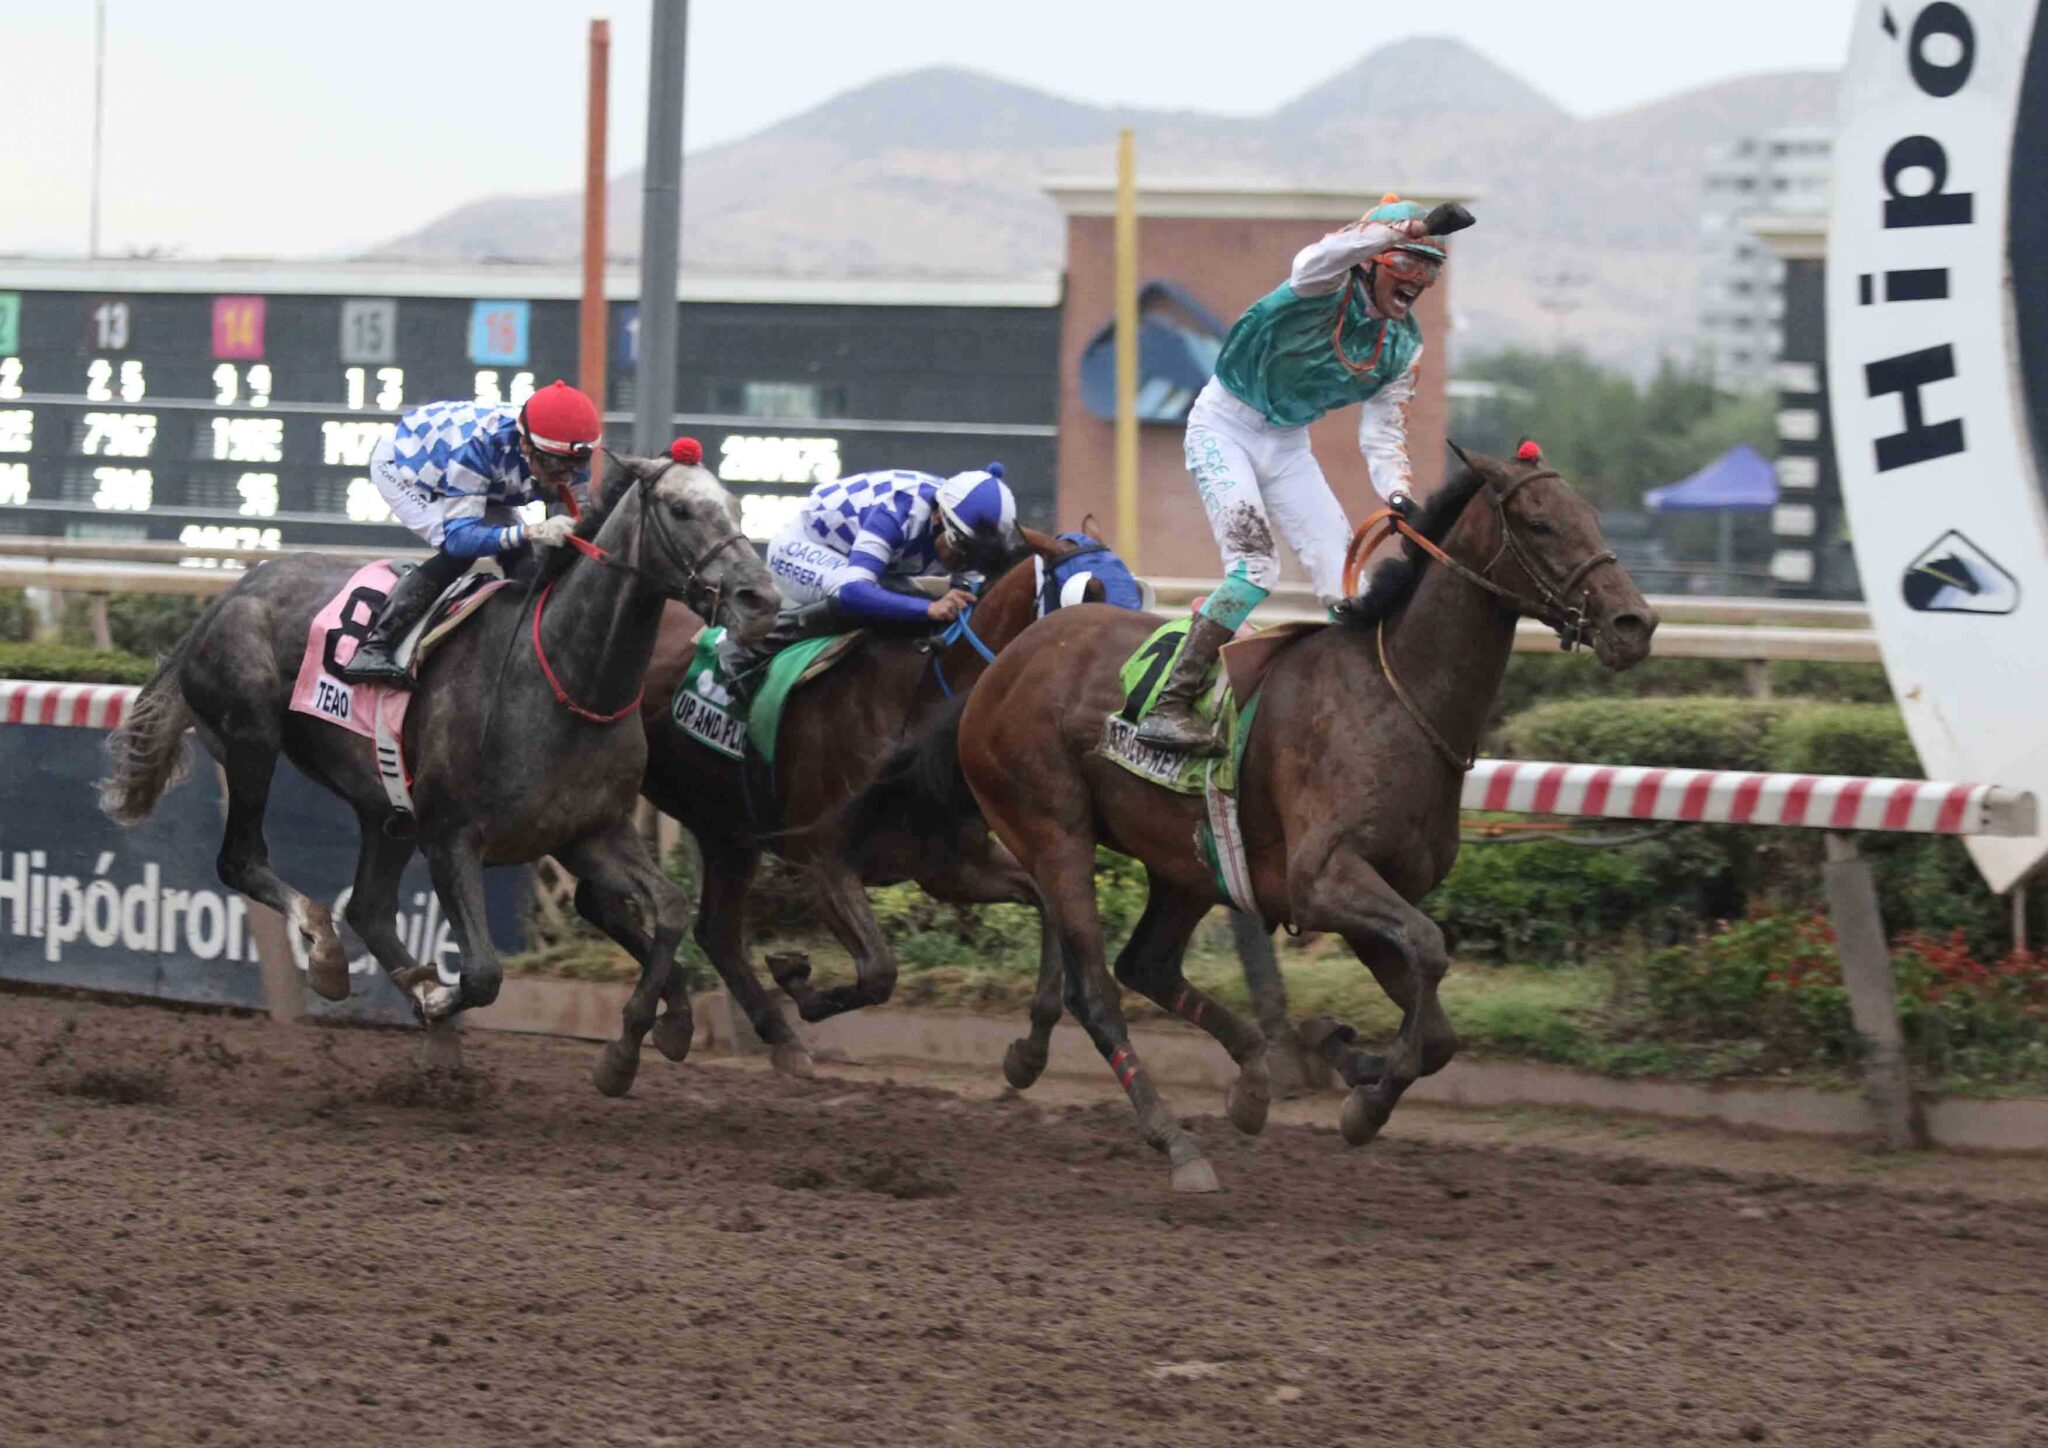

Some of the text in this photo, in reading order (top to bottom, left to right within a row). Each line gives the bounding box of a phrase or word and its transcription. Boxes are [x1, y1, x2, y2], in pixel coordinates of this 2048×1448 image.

[1858, 1, 1975, 472] Hipó
[95, 302, 130, 349] 13
[223, 307, 255, 350] 14
[353, 311, 383, 355] 15
[770, 556, 824, 588] HERRERA
[322, 585, 388, 684] 8
[317, 681, 349, 718] TEAO
[676, 694, 696, 724] UP
[694, 705, 723, 742] AND
